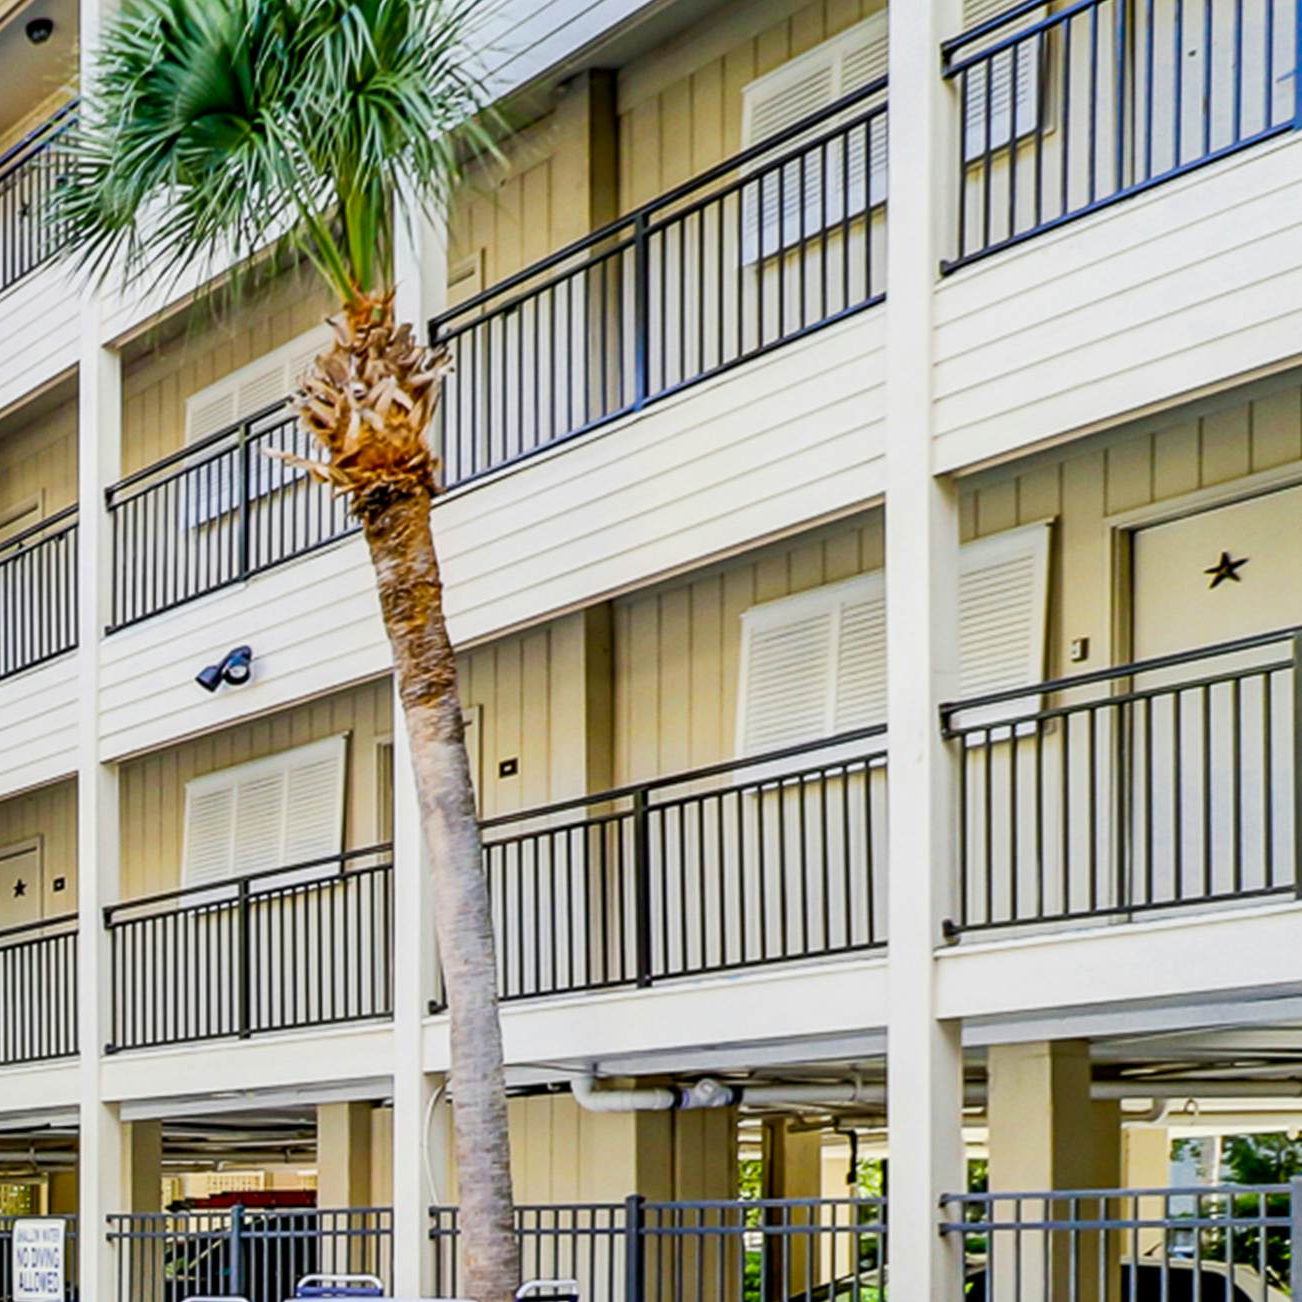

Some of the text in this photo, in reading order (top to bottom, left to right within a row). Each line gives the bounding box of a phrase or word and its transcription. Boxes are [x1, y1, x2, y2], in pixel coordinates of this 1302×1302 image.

[17, 1247, 60, 1269] NO DIVING
[19, 1271, 59, 1292] ALLOWED
